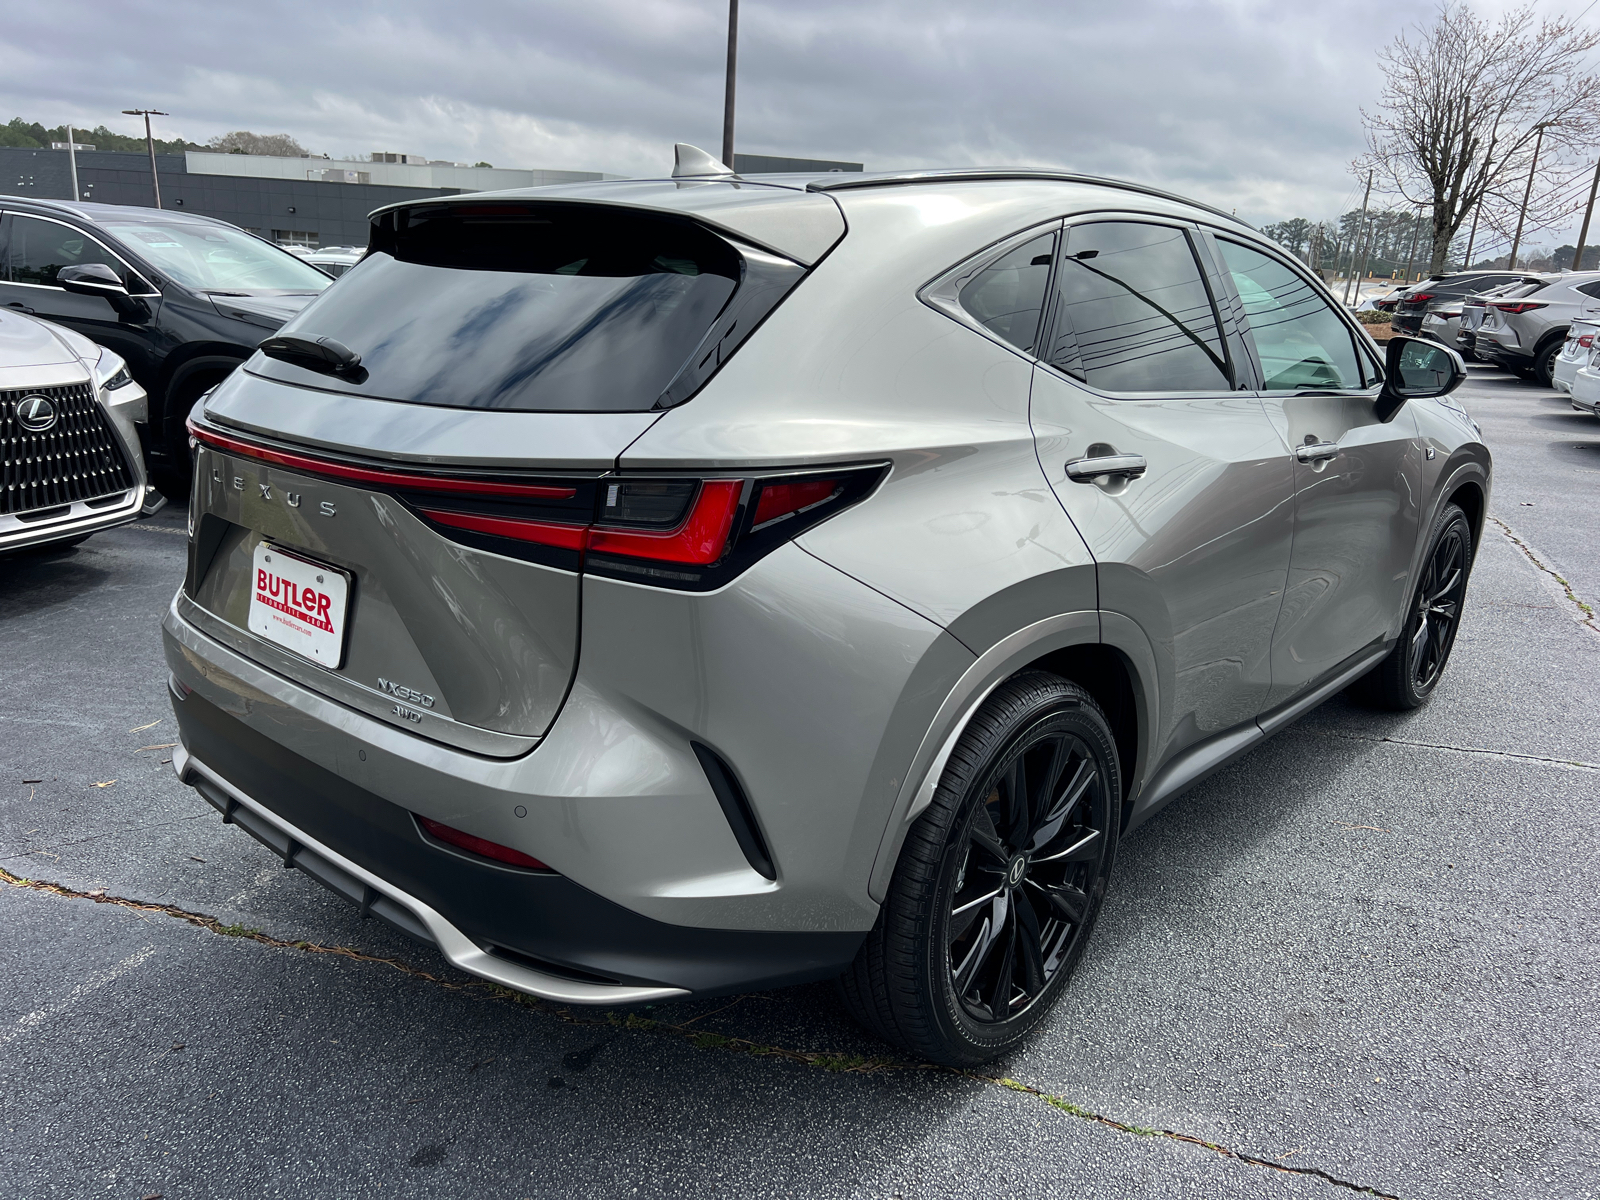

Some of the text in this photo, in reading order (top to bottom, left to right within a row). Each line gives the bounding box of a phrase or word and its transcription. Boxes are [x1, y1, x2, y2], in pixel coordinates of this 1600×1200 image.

[213, 468, 337, 517] LEXUS
[377, 677, 435, 708] NX350
[391, 704, 422, 723] AWD
